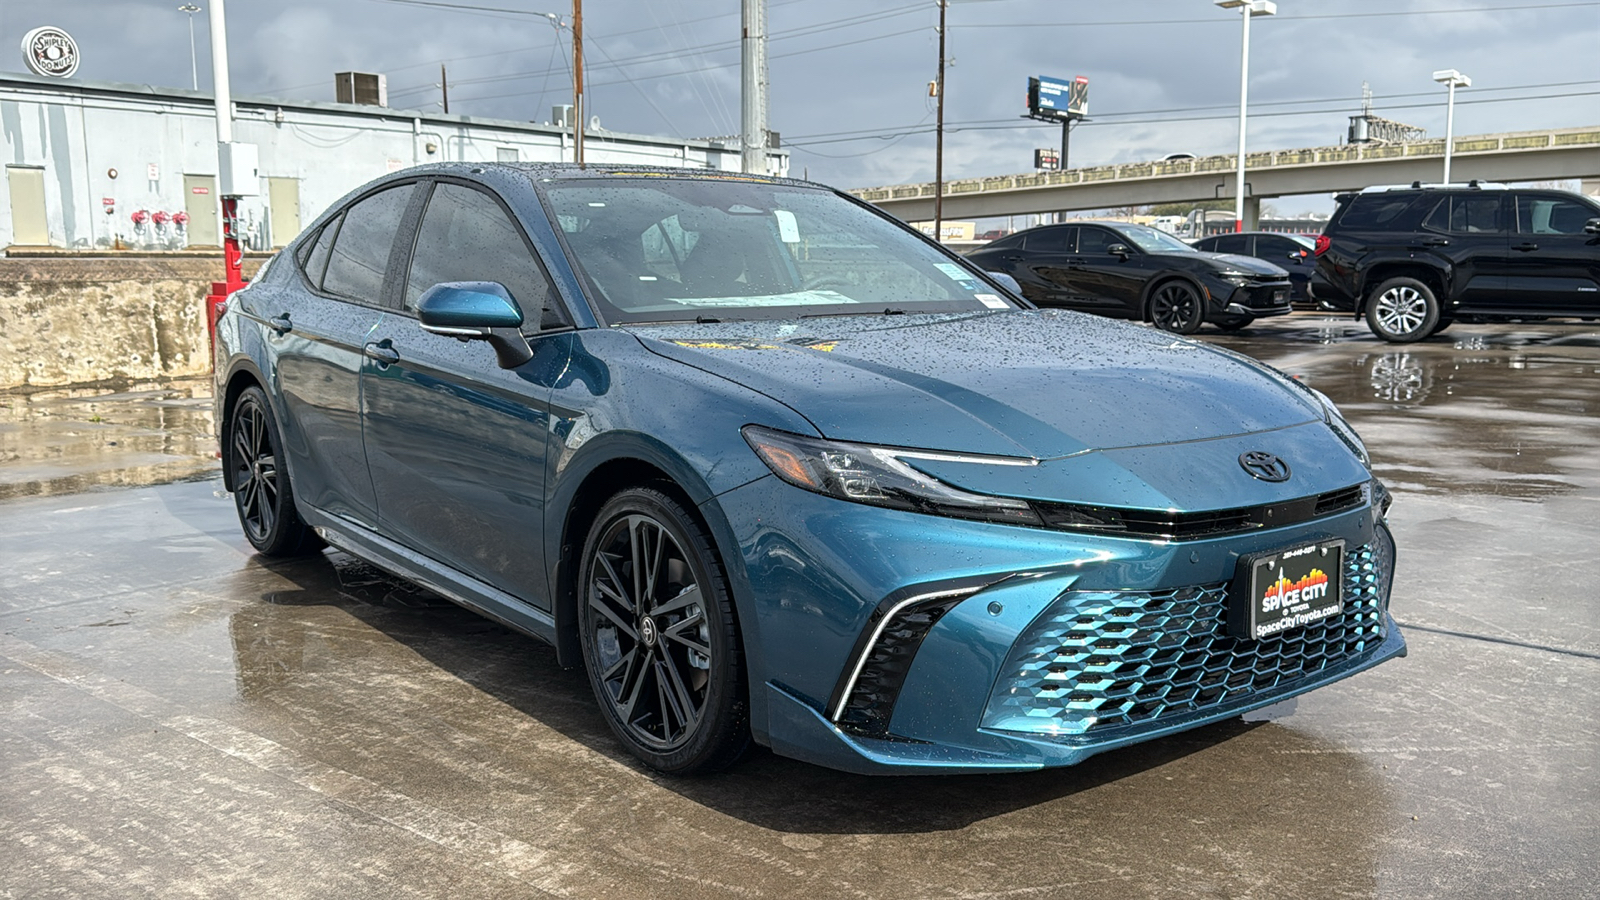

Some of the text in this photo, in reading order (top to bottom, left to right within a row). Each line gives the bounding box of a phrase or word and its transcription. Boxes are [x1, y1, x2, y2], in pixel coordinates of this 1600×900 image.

[36, 36, 69, 50] SHIPLEY
[1262, 581, 1328, 612] SPACE CITY
[1290, 603, 1310, 613] TOYOTA
[1256, 604, 1339, 637] SpaceCityToyota.com
